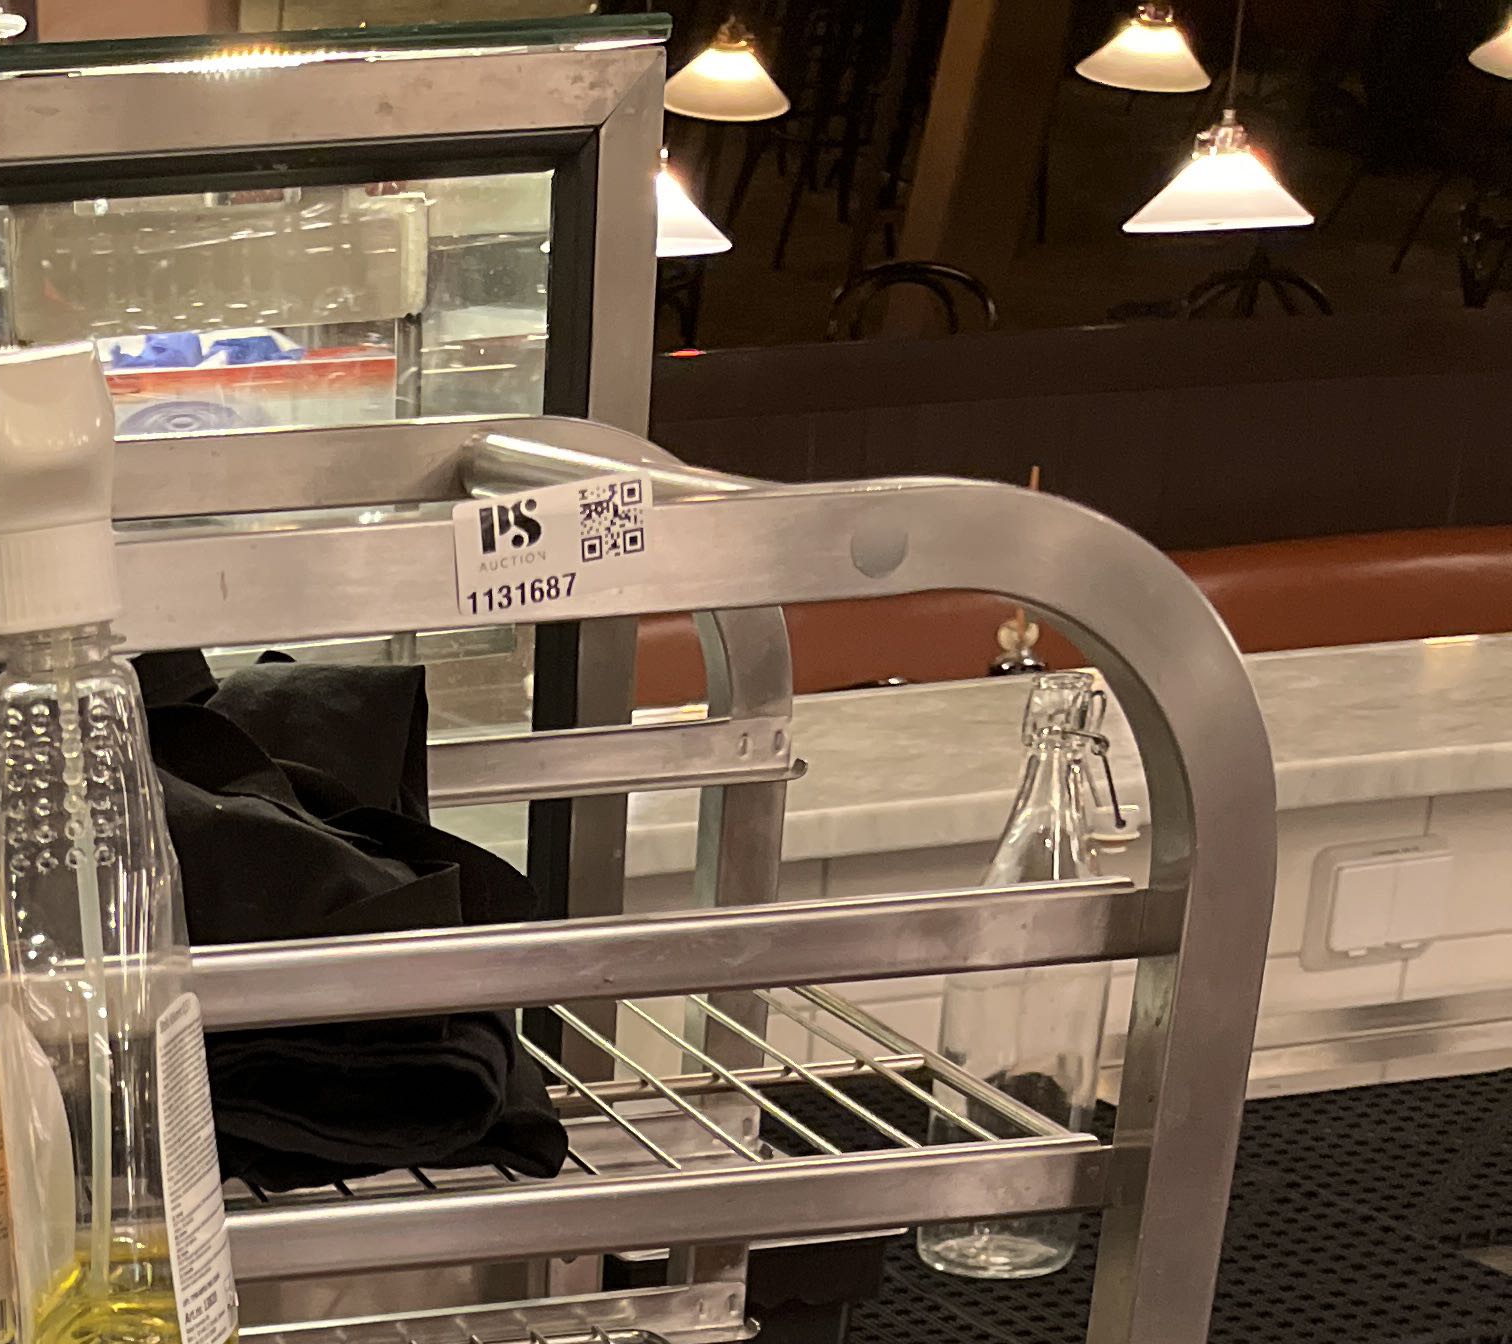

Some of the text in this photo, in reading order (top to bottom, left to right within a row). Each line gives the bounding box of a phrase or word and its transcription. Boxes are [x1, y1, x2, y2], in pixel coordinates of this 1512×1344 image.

[479, 499, 542, 554] PS
[480, 551, 547, 573] AUCTION
[466, 572, 576, 614] 1131687
